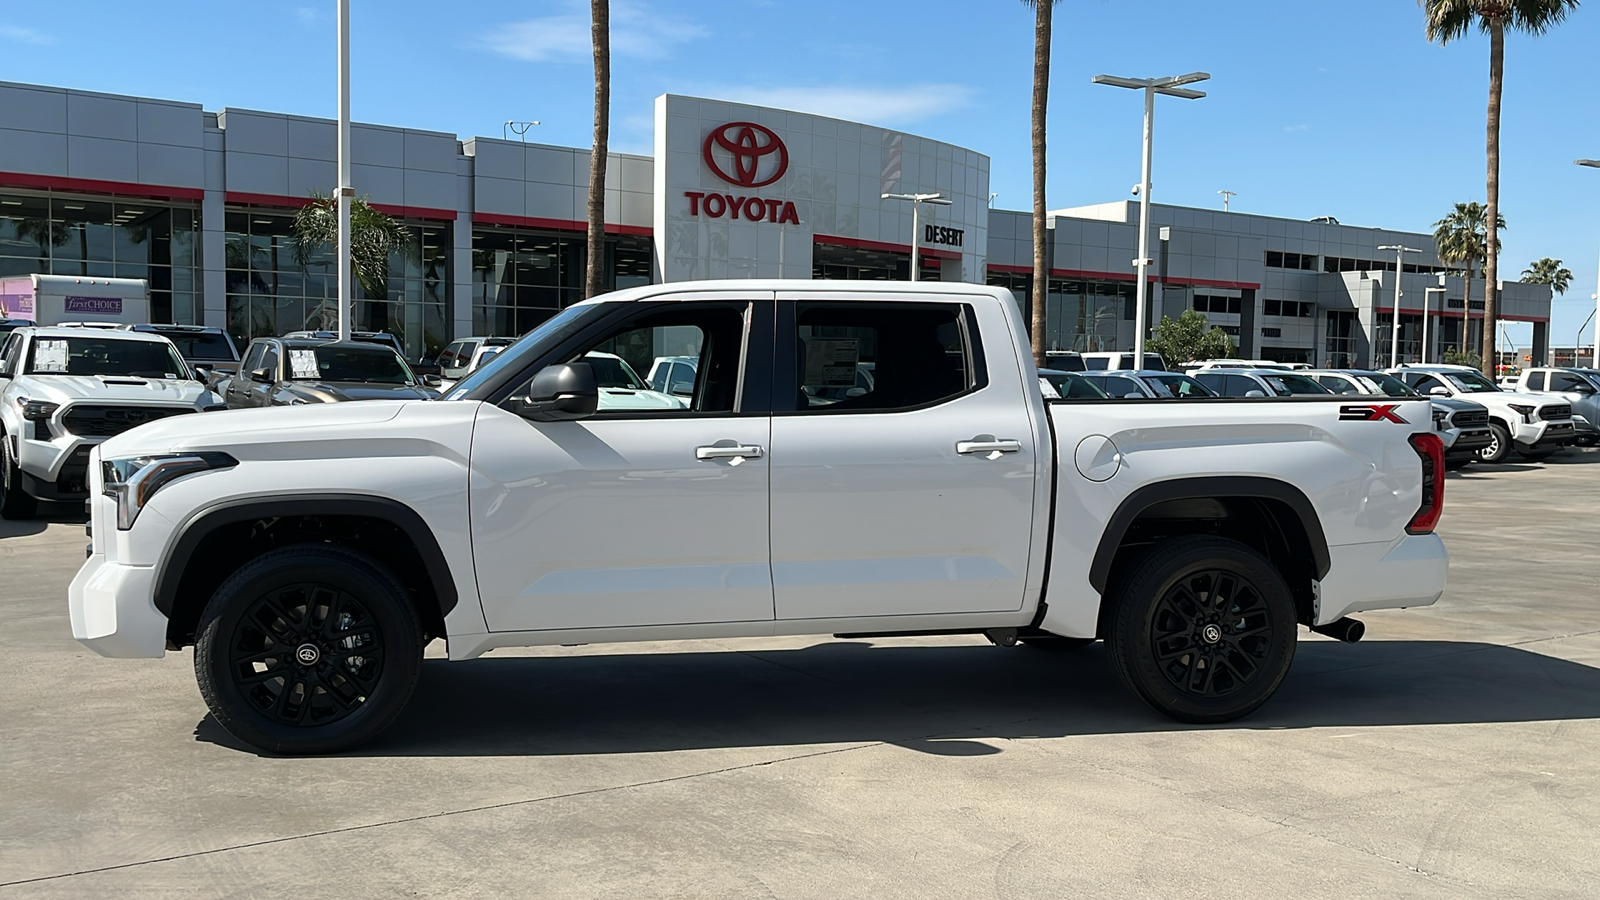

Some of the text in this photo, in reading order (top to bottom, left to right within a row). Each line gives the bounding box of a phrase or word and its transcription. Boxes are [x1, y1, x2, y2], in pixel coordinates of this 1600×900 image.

[684, 191, 800, 225] TOYOTA
[925, 224, 964, 246] DESERT
[1338, 404, 1411, 424] SX
